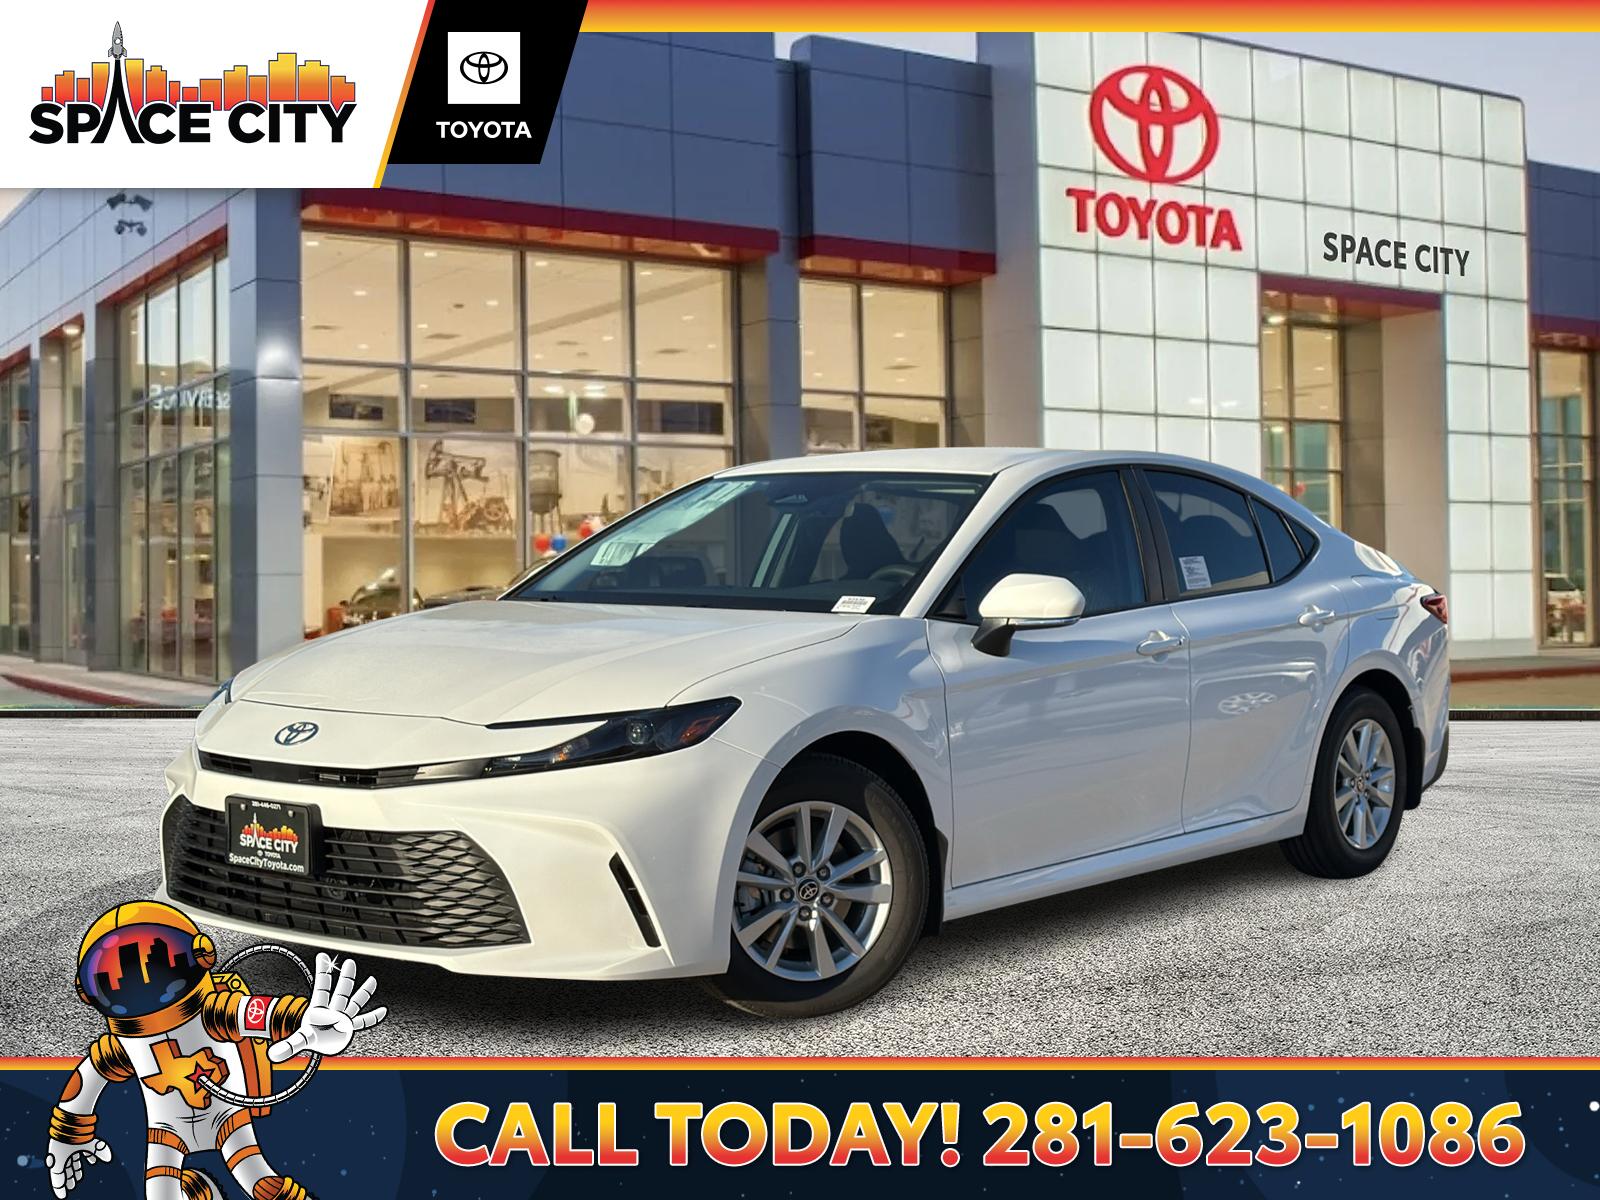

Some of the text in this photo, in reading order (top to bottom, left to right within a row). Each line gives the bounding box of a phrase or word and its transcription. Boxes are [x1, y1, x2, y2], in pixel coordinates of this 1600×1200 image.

[1066, 187, 1243, 252] TOYOTA
[1322, 231, 1470, 277] SPACE CITY
[240, 831, 299, 854] SPACE CITY
[229, 853, 304, 873] SpaceCityToyota.com
[264, 851, 281, 859] TOYOTA
